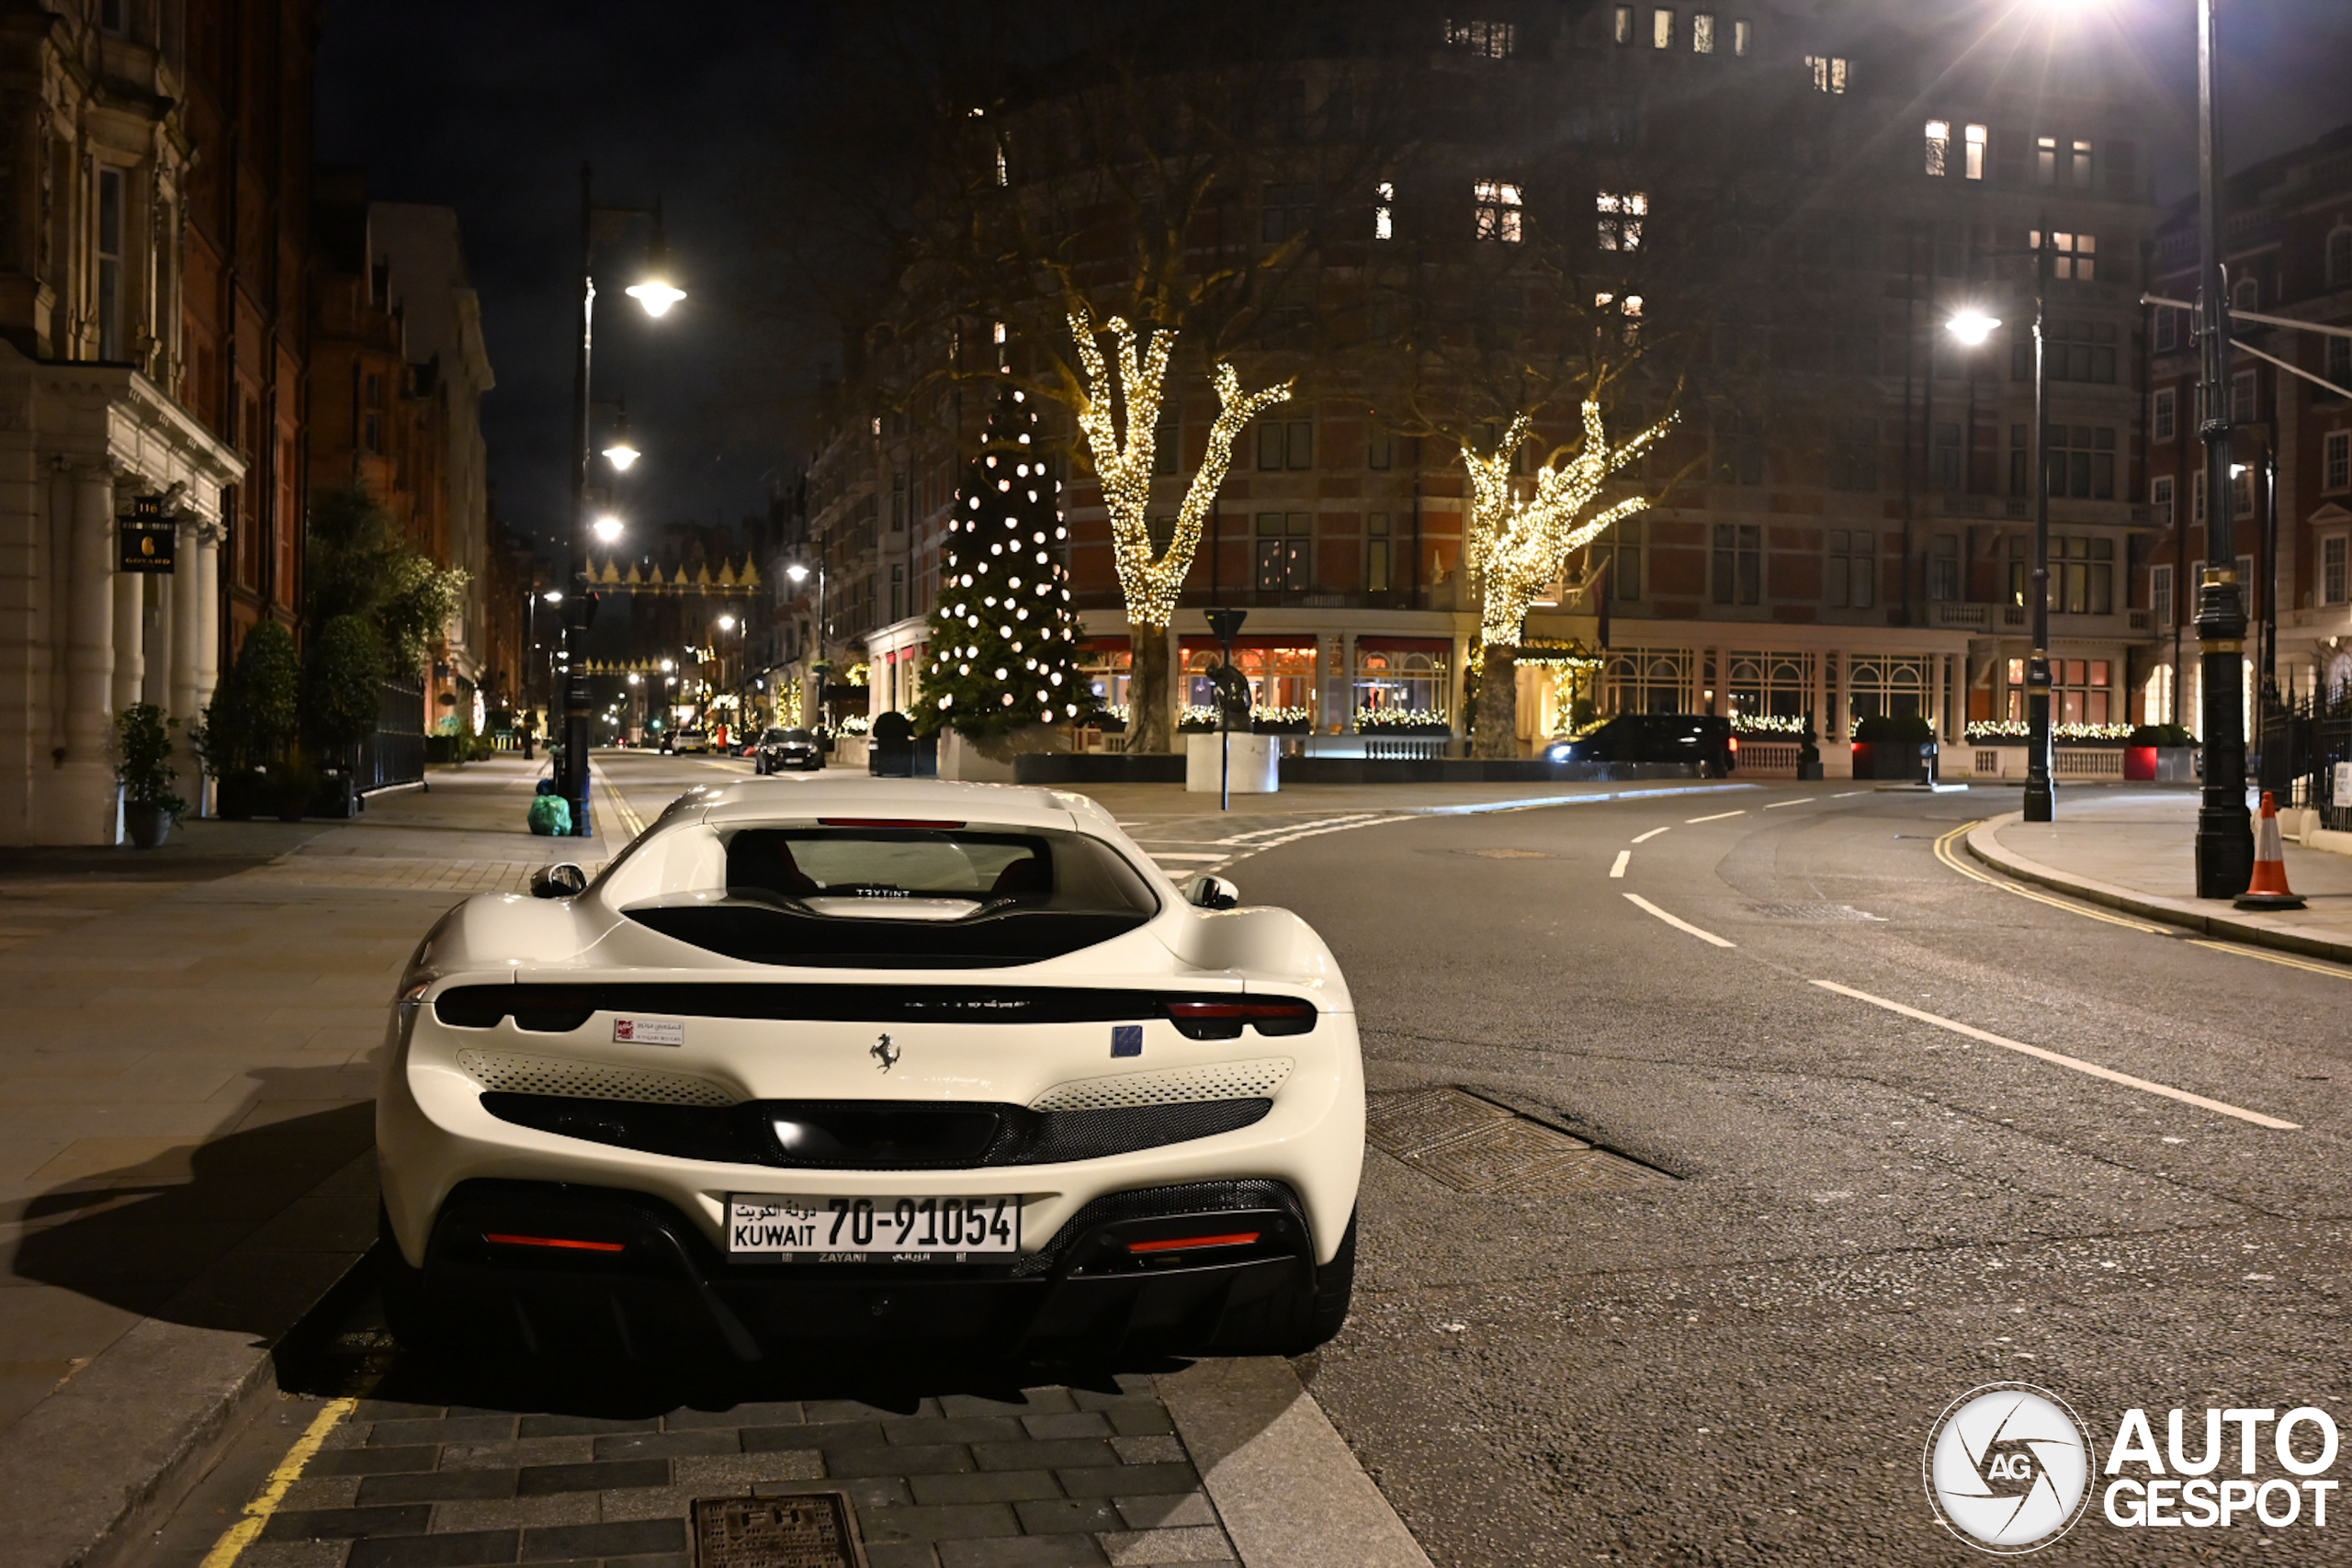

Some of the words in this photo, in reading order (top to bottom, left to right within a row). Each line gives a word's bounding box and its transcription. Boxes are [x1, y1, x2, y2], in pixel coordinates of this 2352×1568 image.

[735, 1202, 781, 1222] الكويت
[786, 1199, 817, 1221] دولة
[829, 1199, 1011, 1246] 70-91054
[735, 1225, 816, 1247] KUWAIT
[818, 1252, 866, 1263] ZAYANI
